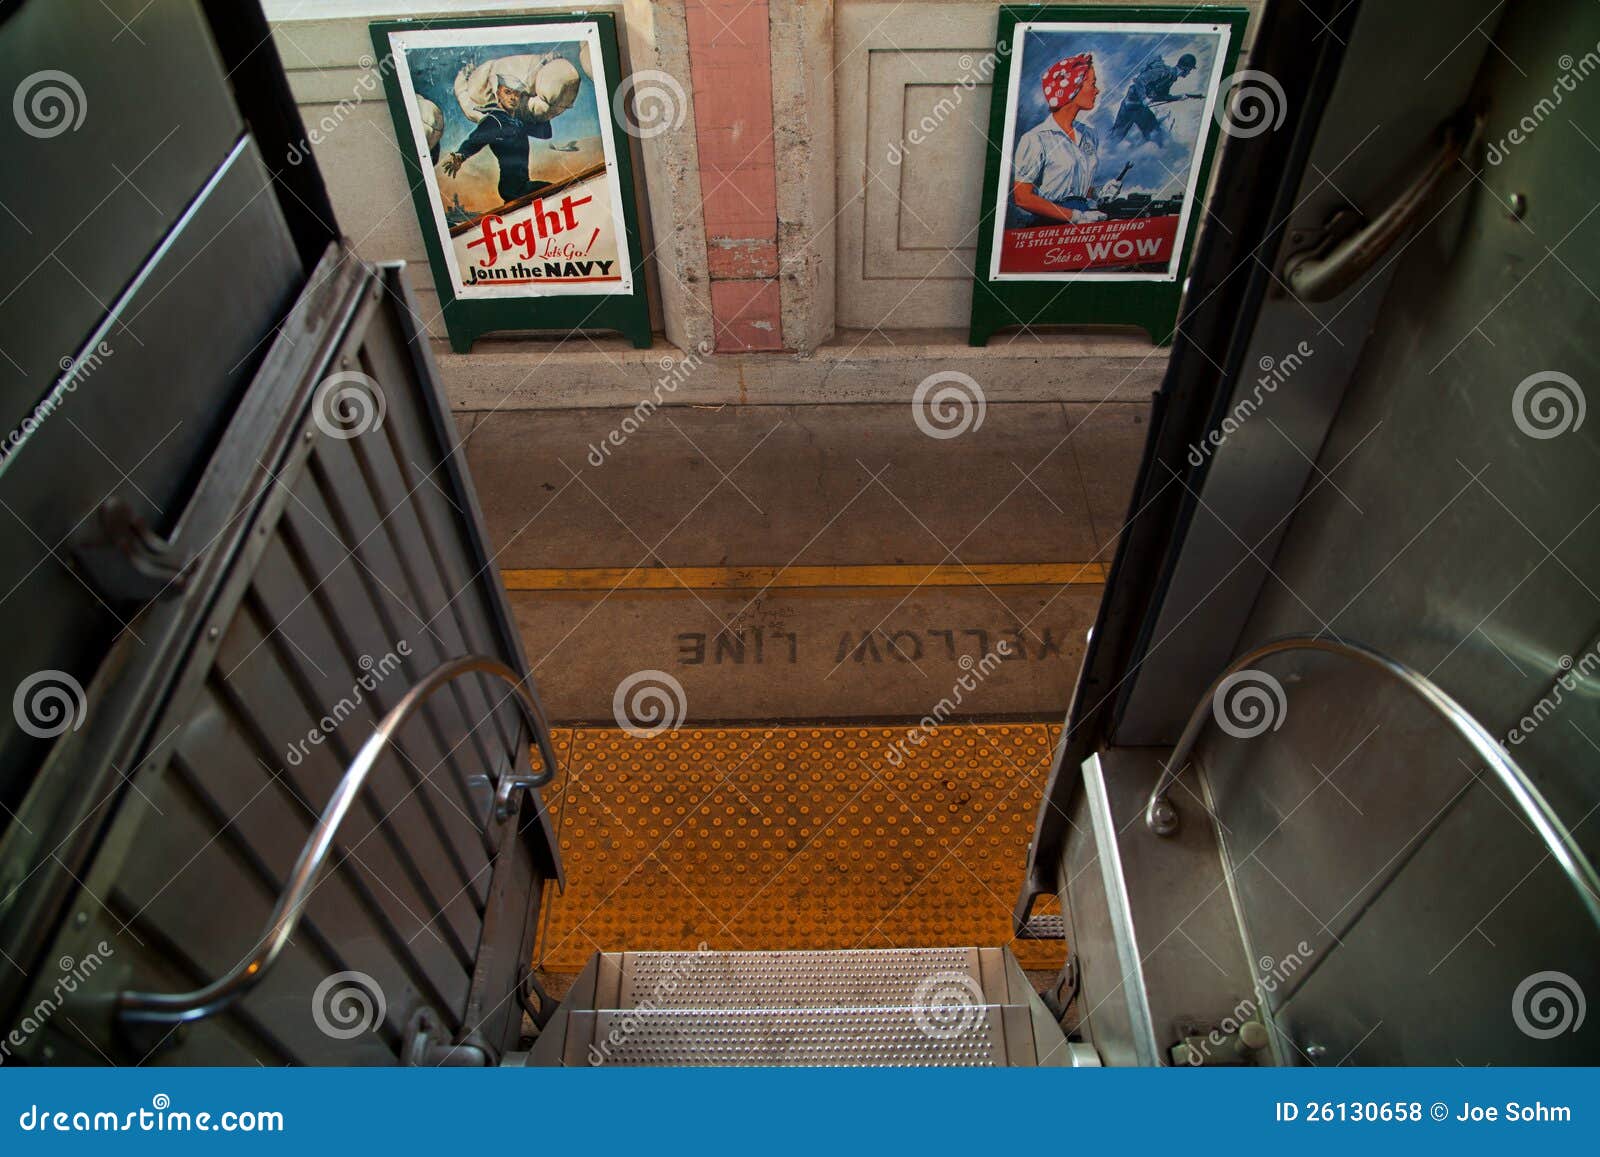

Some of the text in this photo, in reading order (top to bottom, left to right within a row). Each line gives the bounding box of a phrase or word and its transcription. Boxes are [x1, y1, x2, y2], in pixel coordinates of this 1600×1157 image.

[466, 195, 593, 268] fight
[563, 227, 600, 261] Go!
[1015, 232, 1121, 249] IS STILL BEHIND HIM
[1038, 229, 1060, 238] GIRL
[1063, 227, 1077, 236] HE
[1080, 225, 1104, 235] LEFT
[1044, 237, 1163, 265] She's a WOW
[463, 260, 615, 286] Join the NAVY
[675, 627, 1064, 665] YELLOW LINE
